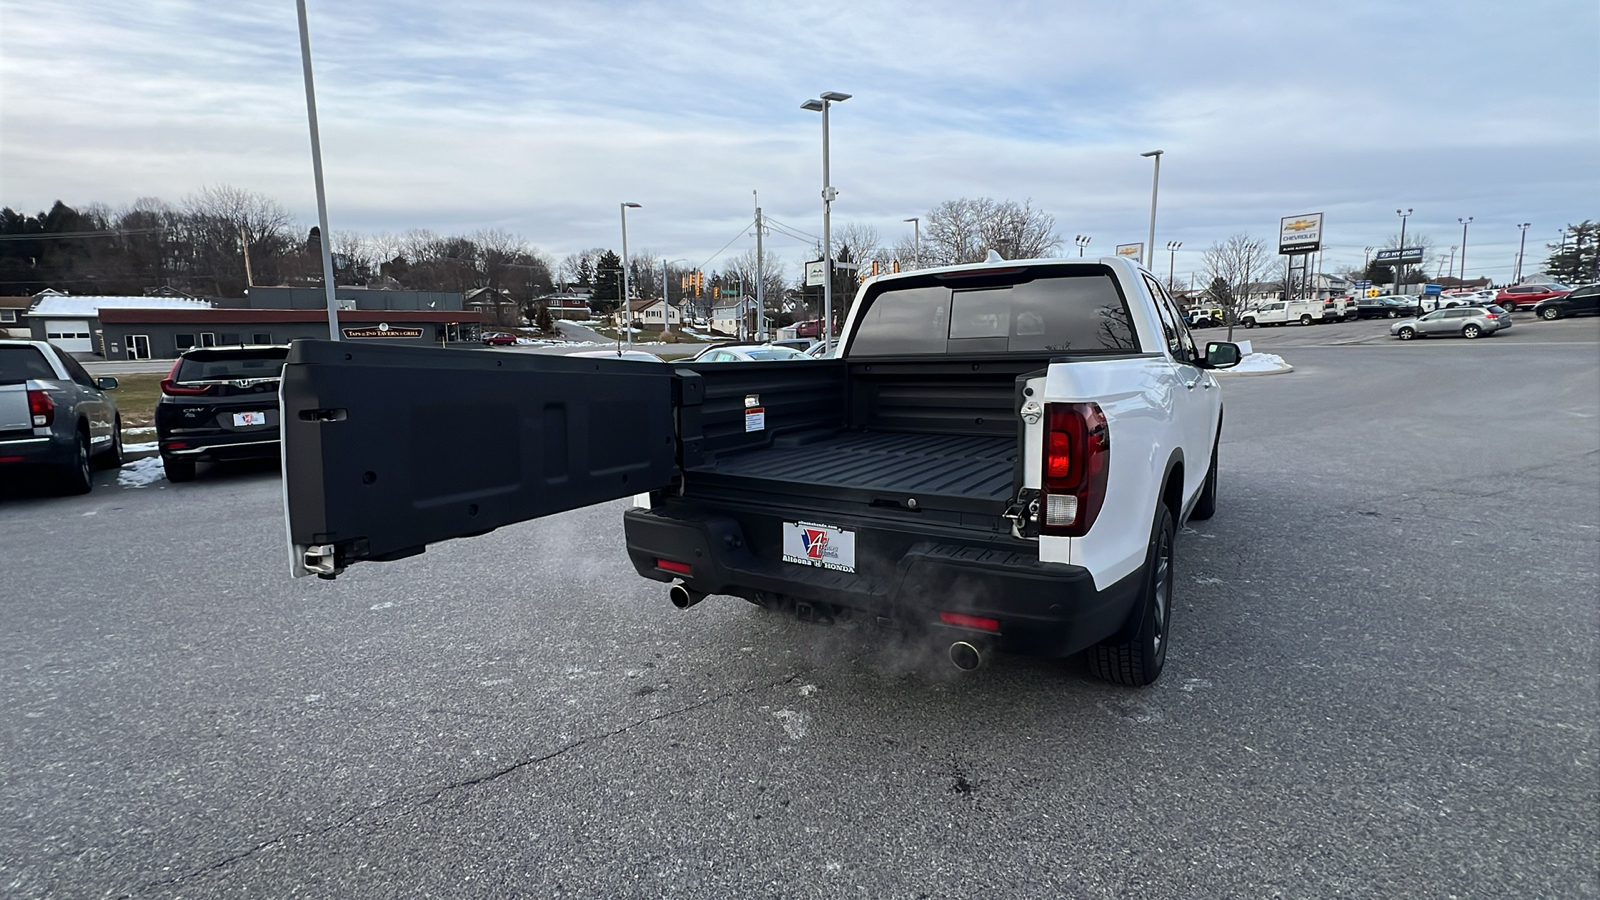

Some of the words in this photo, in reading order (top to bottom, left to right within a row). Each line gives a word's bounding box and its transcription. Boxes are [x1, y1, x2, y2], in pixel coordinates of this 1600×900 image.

[1283, 233, 1316, 241] CHEVROLET
[782, 555, 812, 565] Altoona
[824, 562, 855, 573] HONDA
